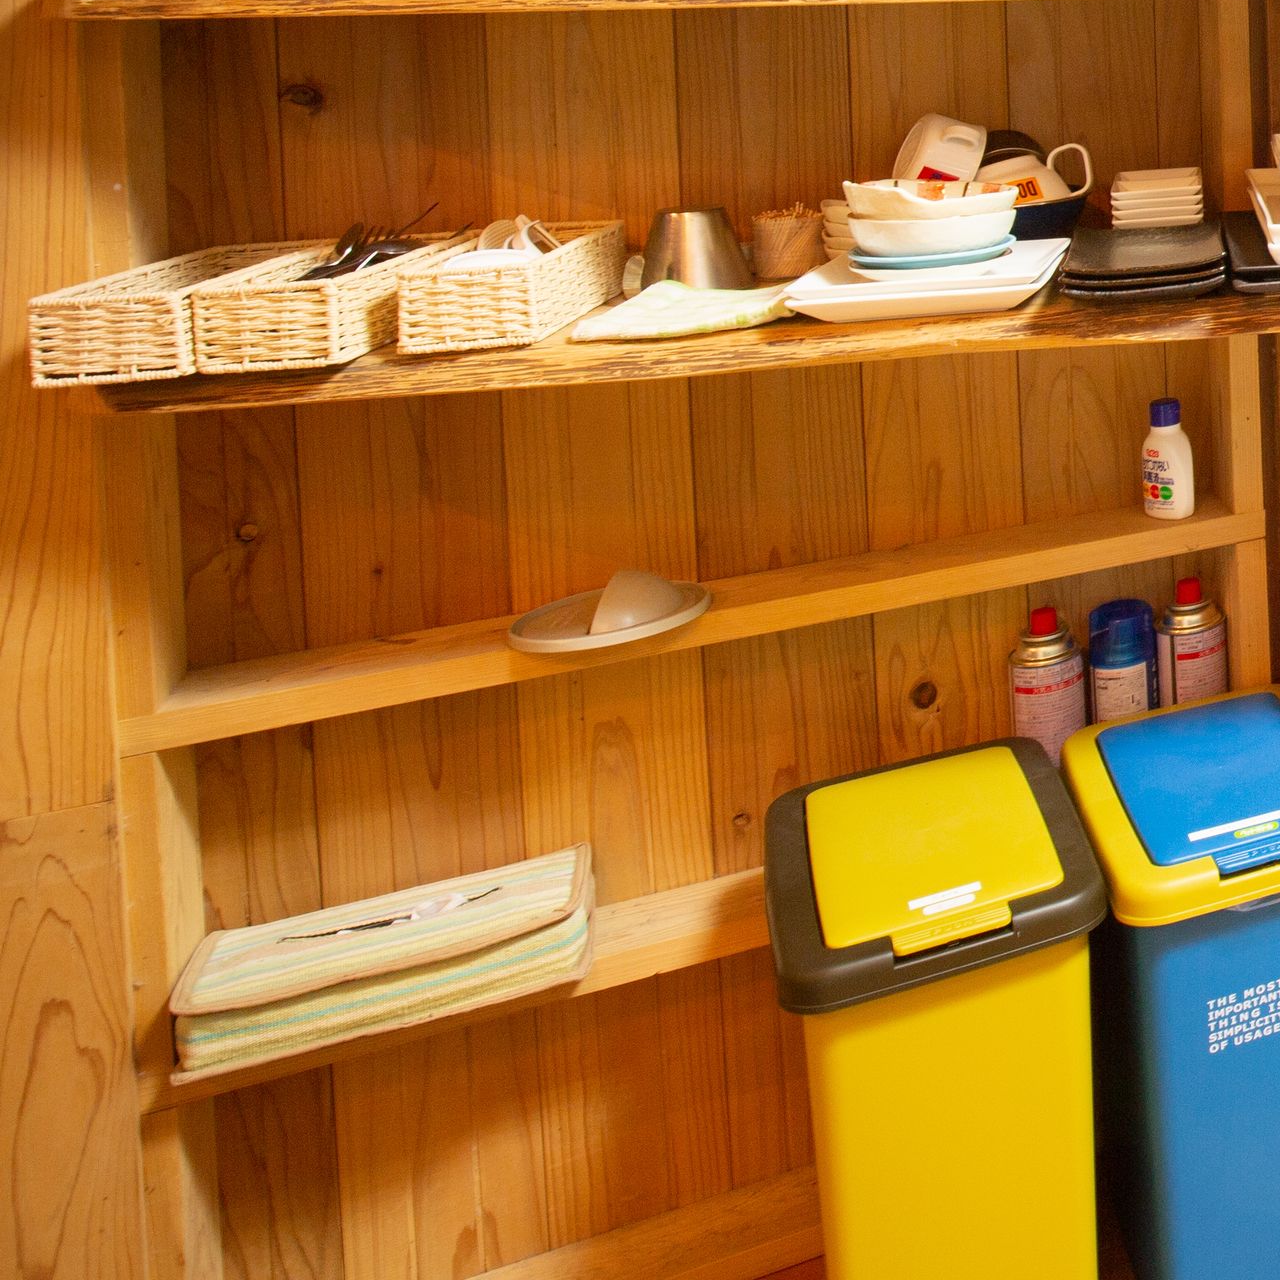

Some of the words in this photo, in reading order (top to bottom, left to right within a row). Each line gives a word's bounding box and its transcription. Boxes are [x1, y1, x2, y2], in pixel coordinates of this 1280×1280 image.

[1206, 993, 1237, 1010] THE
[1207, 1008, 1261, 1032] THING
[1209, 1040, 1230, 1054] OF
